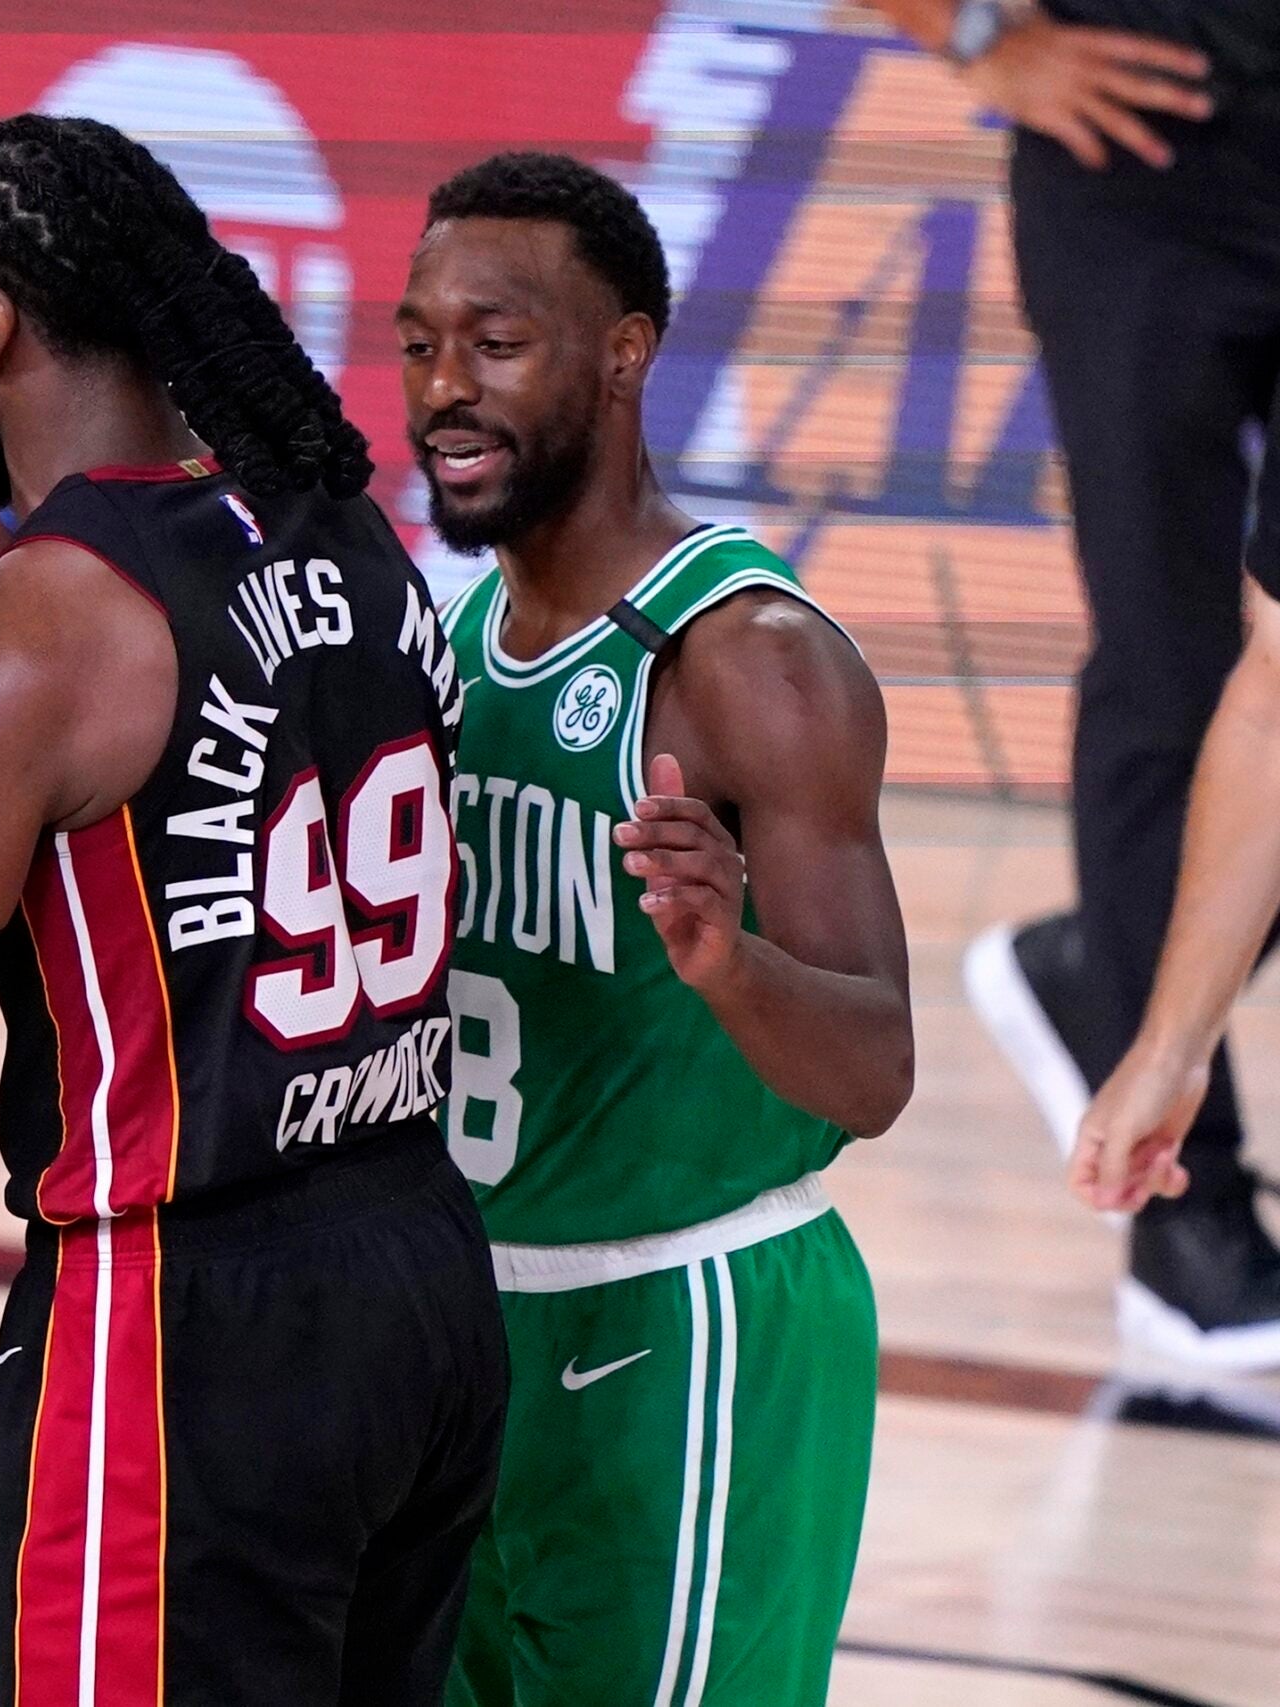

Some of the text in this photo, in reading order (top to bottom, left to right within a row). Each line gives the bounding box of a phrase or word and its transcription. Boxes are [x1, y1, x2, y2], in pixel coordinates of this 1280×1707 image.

[165, 558, 465, 952] BLACK LIVES MAT
[247, 734, 457, 1050] 99
[447, 968, 523, 1187] 8
